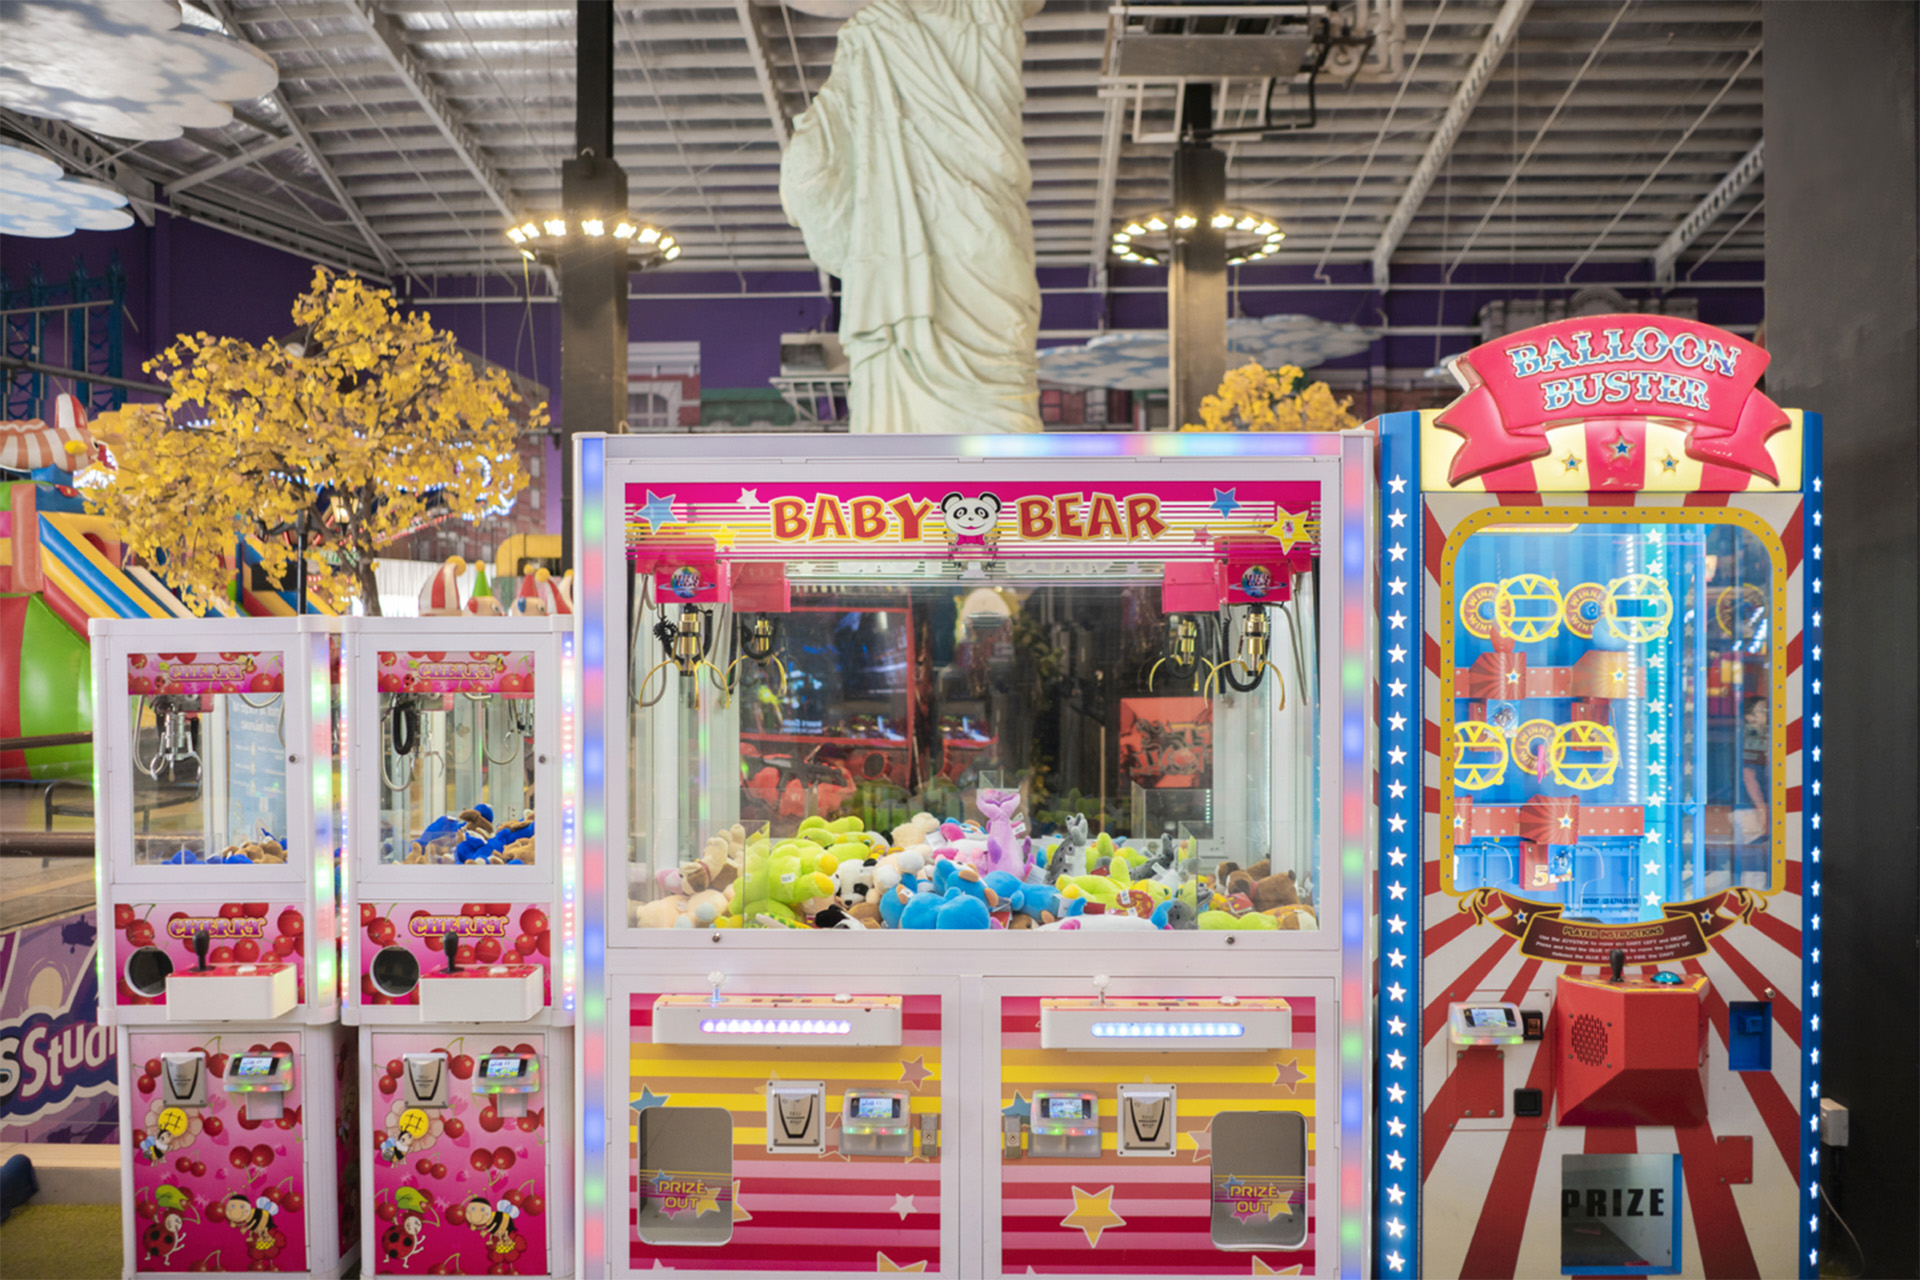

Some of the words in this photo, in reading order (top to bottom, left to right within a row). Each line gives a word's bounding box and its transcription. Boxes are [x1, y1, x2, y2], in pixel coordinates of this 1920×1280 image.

[1507, 327, 1741, 377] BALLOON
[1542, 371, 1710, 411] BUSTER
[771, 493, 934, 543] BABY
[1015, 492, 1171, 543] BEAR
[168, 663, 246, 681] CHERRY
[418, 662, 496, 680] CHERRY
[1532, 865, 1548, 886] 5
[168, 918, 267, 938] CHERRY
[409, 916, 509, 937] CHERRY
[1563, 926, 1599, 939] PLAYER
[1599, 926, 1664, 939] INSTRUCTIONS
[659, 1181, 706, 1194] PRIZE
[1230, 1186, 1278, 1198] PRIZE
[665, 1196, 699, 1209] OUT
[1236, 1201, 1272, 1213] OUT
[1561, 1188, 1664, 1217] PRIZE
